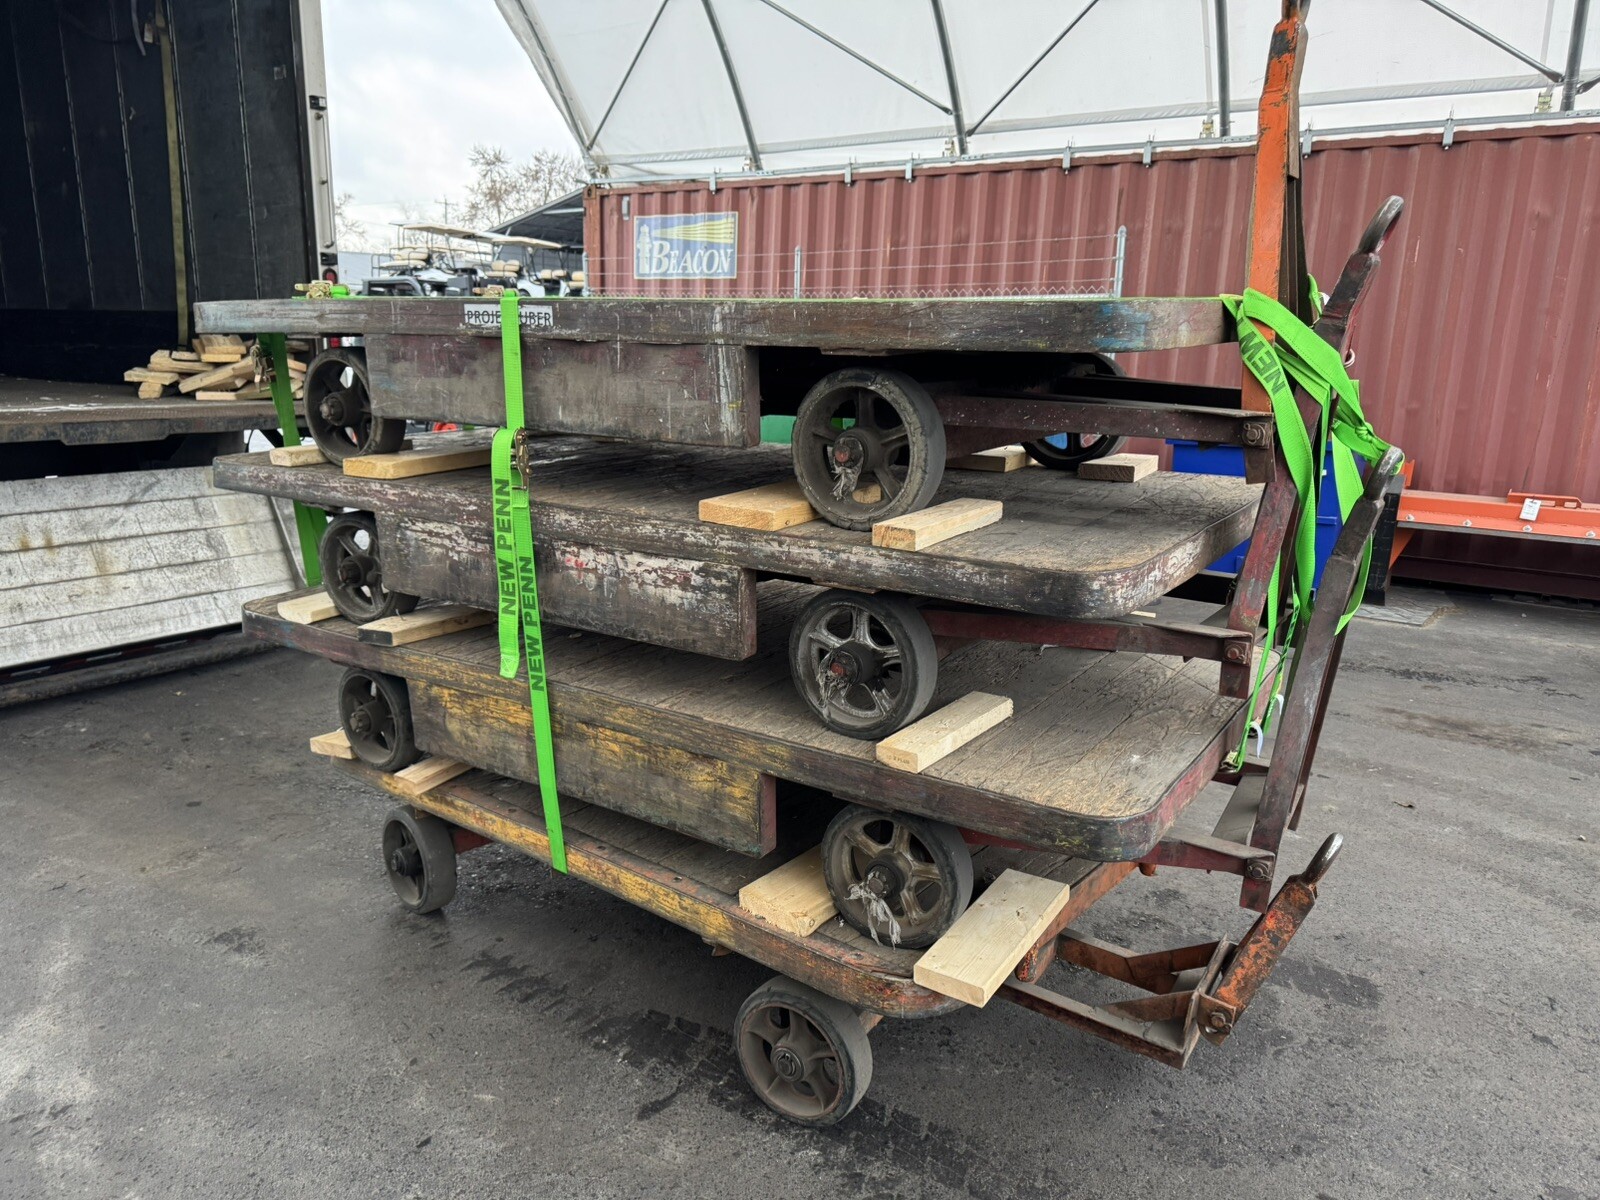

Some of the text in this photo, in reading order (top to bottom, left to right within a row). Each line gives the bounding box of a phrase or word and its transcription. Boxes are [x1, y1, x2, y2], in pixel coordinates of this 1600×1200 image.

[651, 240, 733, 274] BEACON
[466, 310, 502, 325] PROJE
[1240, 331, 1286, 395] NEW
[494, 478, 516, 616] NEW PENN
[518, 556, 545, 692] NEW PENN
